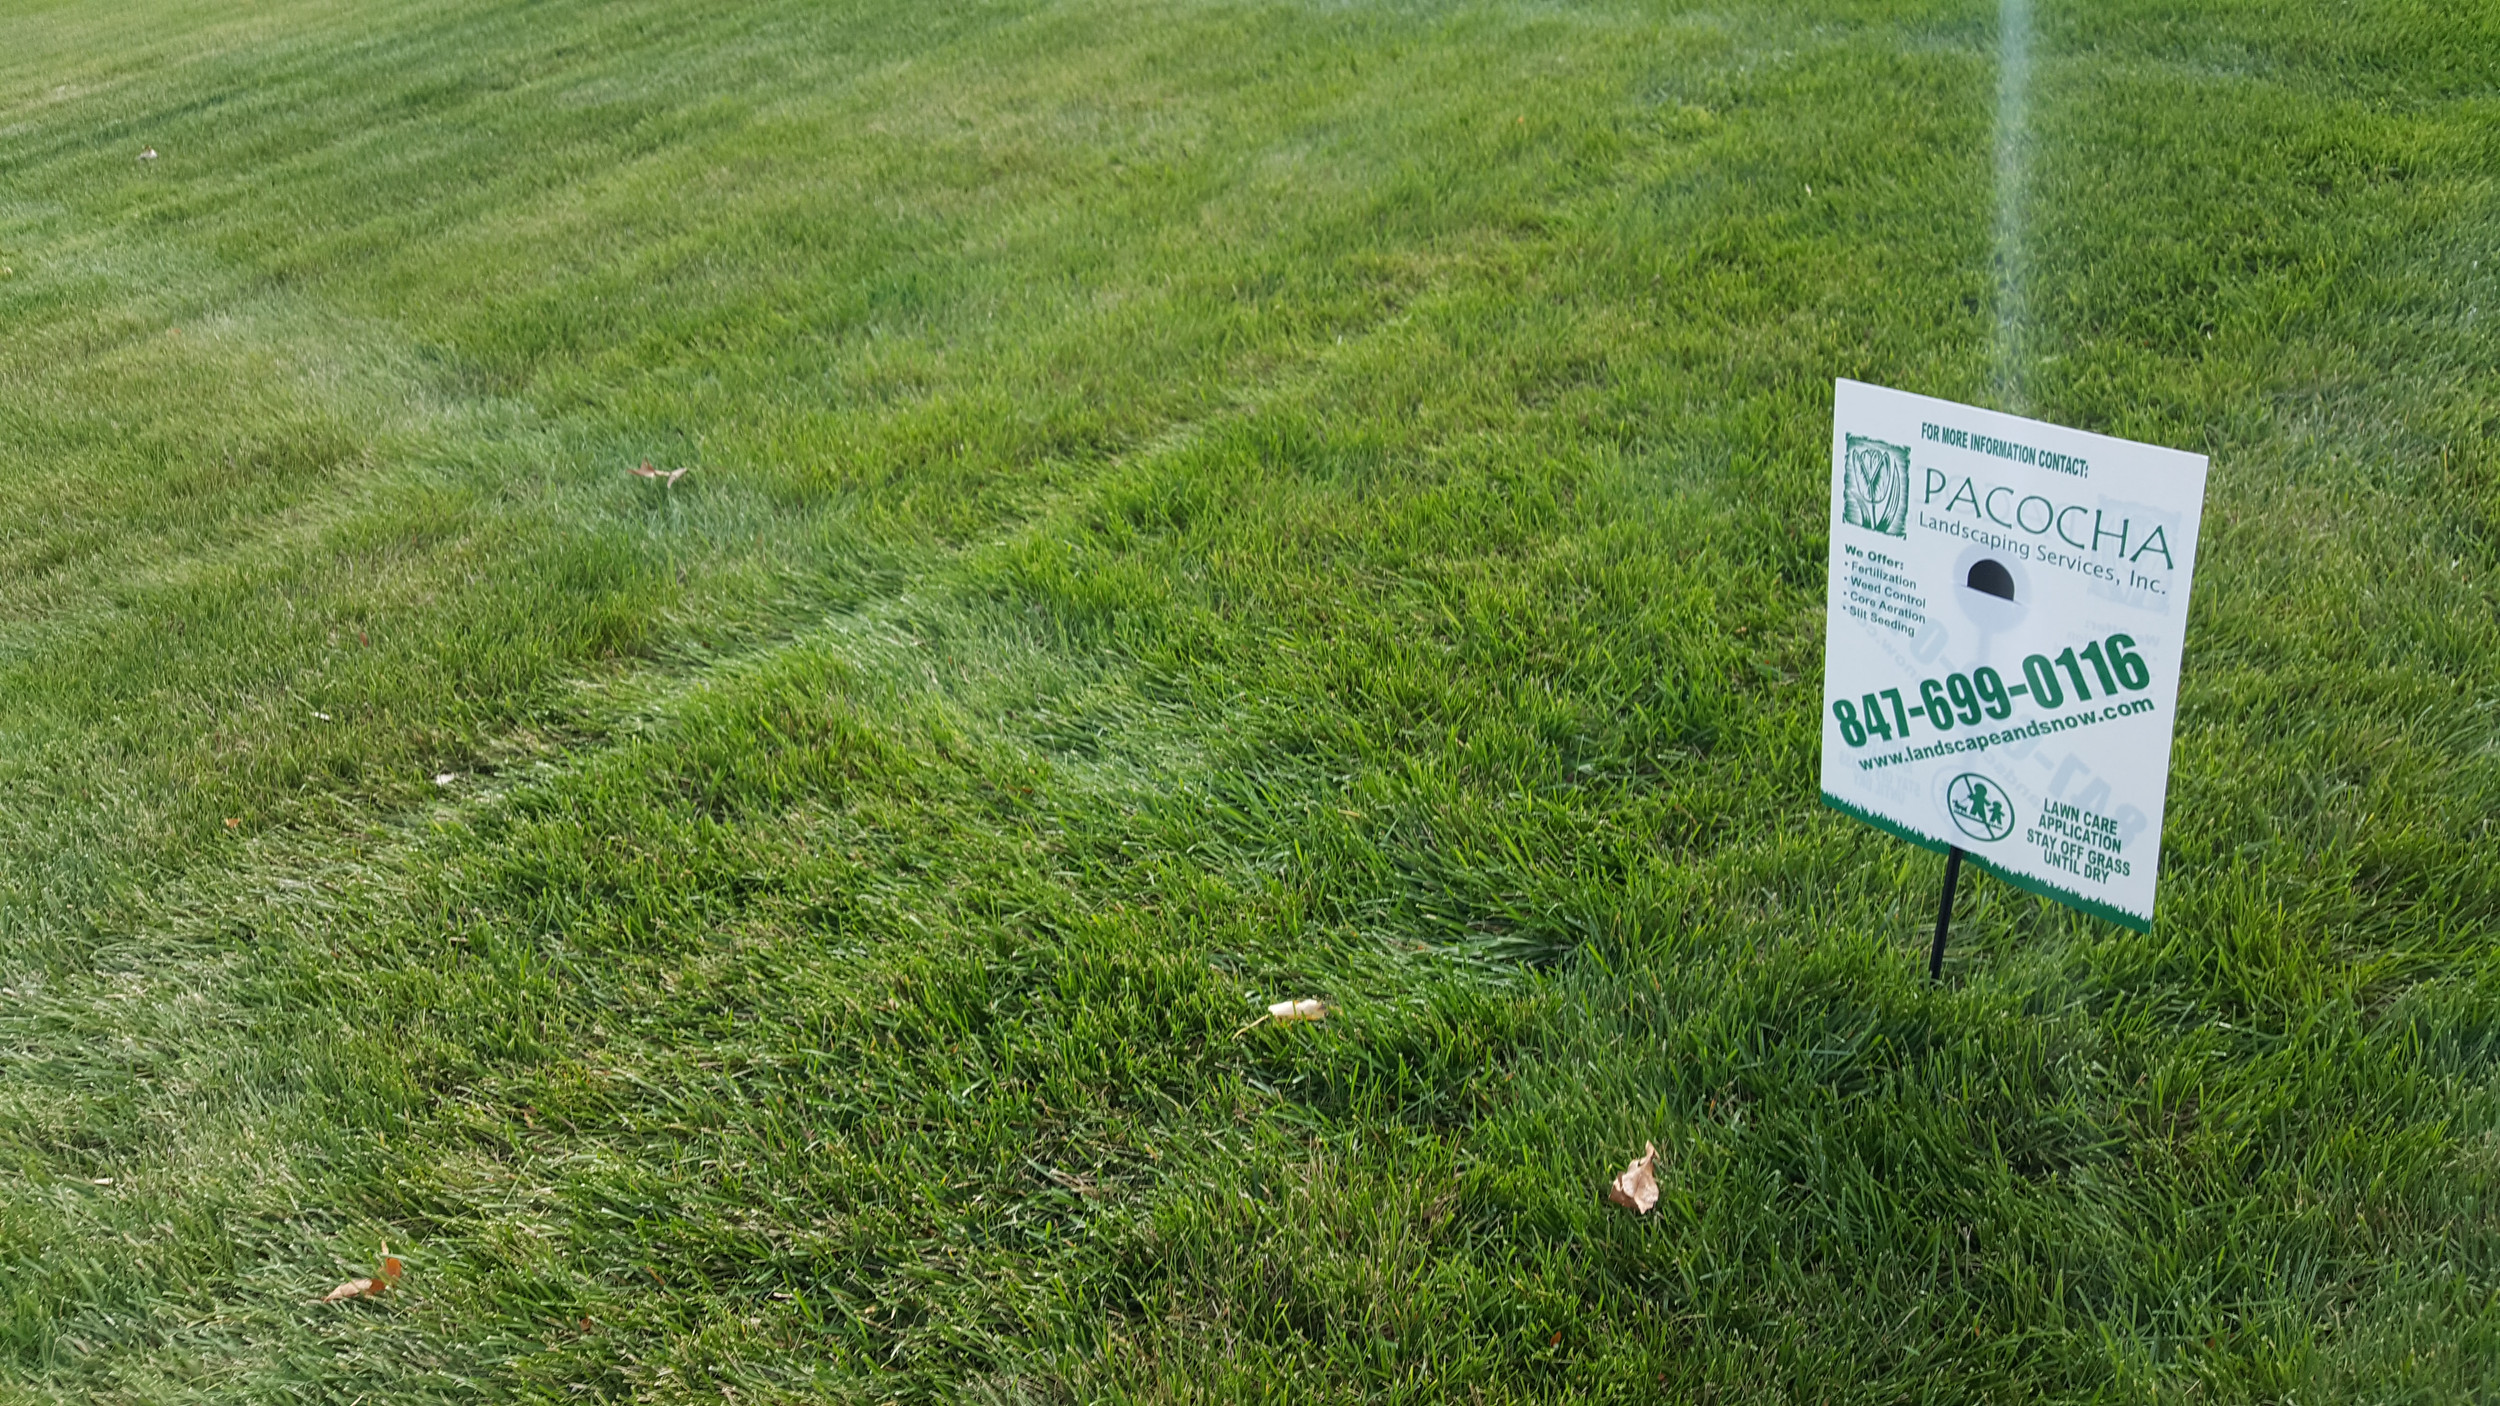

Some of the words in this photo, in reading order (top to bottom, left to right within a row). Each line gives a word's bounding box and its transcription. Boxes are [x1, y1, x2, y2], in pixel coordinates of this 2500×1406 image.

[1921, 421, 1939, 442] FOR
[1942, 426, 1968, 449] MORE
[1970, 433, 2036, 466] INFORMATION
[2038, 449, 2088, 479] CONTACT:
[1924, 467, 2174, 570] PACOCHA
[1845, 543, 1863, 558] We
[1867, 551, 1904, 570] Offer:
[1919, 511, 2030, 560] Landscaping
[2036, 545, 2121, 586] Services,
[2129, 570, 2166, 595] Inc.
[1850, 575, 1881, 594] Weed
[1884, 586, 1926, 609] Control
[1851, 561, 1917, 590] Fertilization
[1849, 605, 1867, 620] Slit
[1870, 612, 1915, 638] Seeding
[1850, 591, 1876, 607] Core
[1878, 600, 1926, 624] Aeration
[1832, 633, 2151, 748] 847-699-0116
[1858, 695, 2155, 772] www.landscapeandsnow.com
[2038, 813, 2121, 855] APPLICATION
[2044, 797, 2080, 823] LAWN
[2083, 811, 2118, 836] CARE
[2026, 828, 2057, 851] STAY
[2060, 840, 2084, 860] OFF
[2087, 850, 2130, 877] GRASS
[2044, 849, 2080, 876] UNTIL
[2084, 863, 2110, 885] DRY
